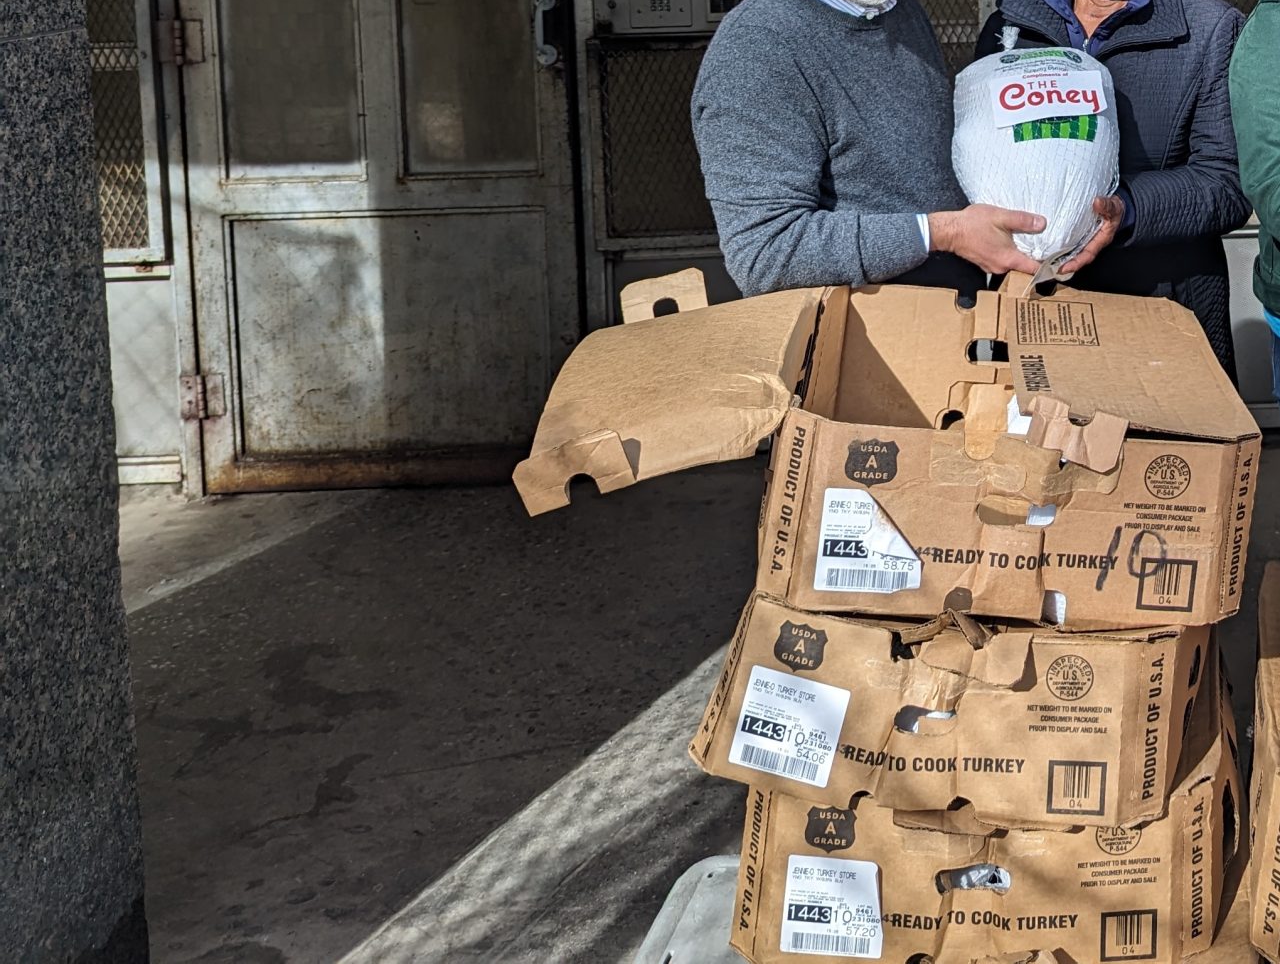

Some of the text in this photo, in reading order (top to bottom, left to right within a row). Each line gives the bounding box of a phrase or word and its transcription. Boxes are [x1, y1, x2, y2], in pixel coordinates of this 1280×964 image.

[1027, 80, 1058, 89] THE
[999, 83, 1101, 113] Coney
[1020, 355, 1052, 391] PERISHABLE
[861, 445, 888, 453] USDA
[865, 455, 878, 469] A
[1147, 456, 1189, 477] INSPECTED
[853, 471, 888, 480] GRADE
[1160, 469, 1177, 480] U.S.
[770, 426, 806, 576] PRODUCT OF U.S.A.
[1156, 489, 1175, 497] P-544
[1229, 453, 1253, 597] PRODUCT OF U.S.A.
[824, 540, 868, 557] 1443
[883, 560, 914, 571] 58.75
[933, 548, 985, 565] READY
[989, 552, 1009, 569] TO
[1057, 552, 1119, 570] TURKEY
[791, 627, 817, 640] USDA
[793, 639, 806, 654] A
[781, 652, 815, 667] GRADE
[1050, 656, 1092, 677] INSPECTED
[1062, 670, 1079, 681] U.S.
[777, 684, 797, 696] TURKEY
[799, 691, 817, 702] STORE
[744, 717, 785, 740] 1443
[1142, 652, 1165, 800] PRODUCT OF U.S.A.
[796, 748, 825, 764] 54.06
[888, 756, 906, 772] TO
[912, 757, 957, 773] COOK
[963, 757, 1025, 773] TURKEY
[819, 811, 846, 821] USDA
[824, 821, 837, 835] A
[813, 837, 847, 846] GRADE
[739, 790, 764, 931] PRODUCT OF U.S.A.
[1191, 797, 1205, 939] PRODUCT OF U.S.A.
[817, 868, 837, 878] TURKEY
[839, 871, 856, 880] STORE
[789, 905, 831, 922] 1443
[892, 909, 1078, 931] READY TO COOK TURKEY
[1263, 892, 1280, 935] U.S.A.
[846, 926, 876, 937] 57.20
